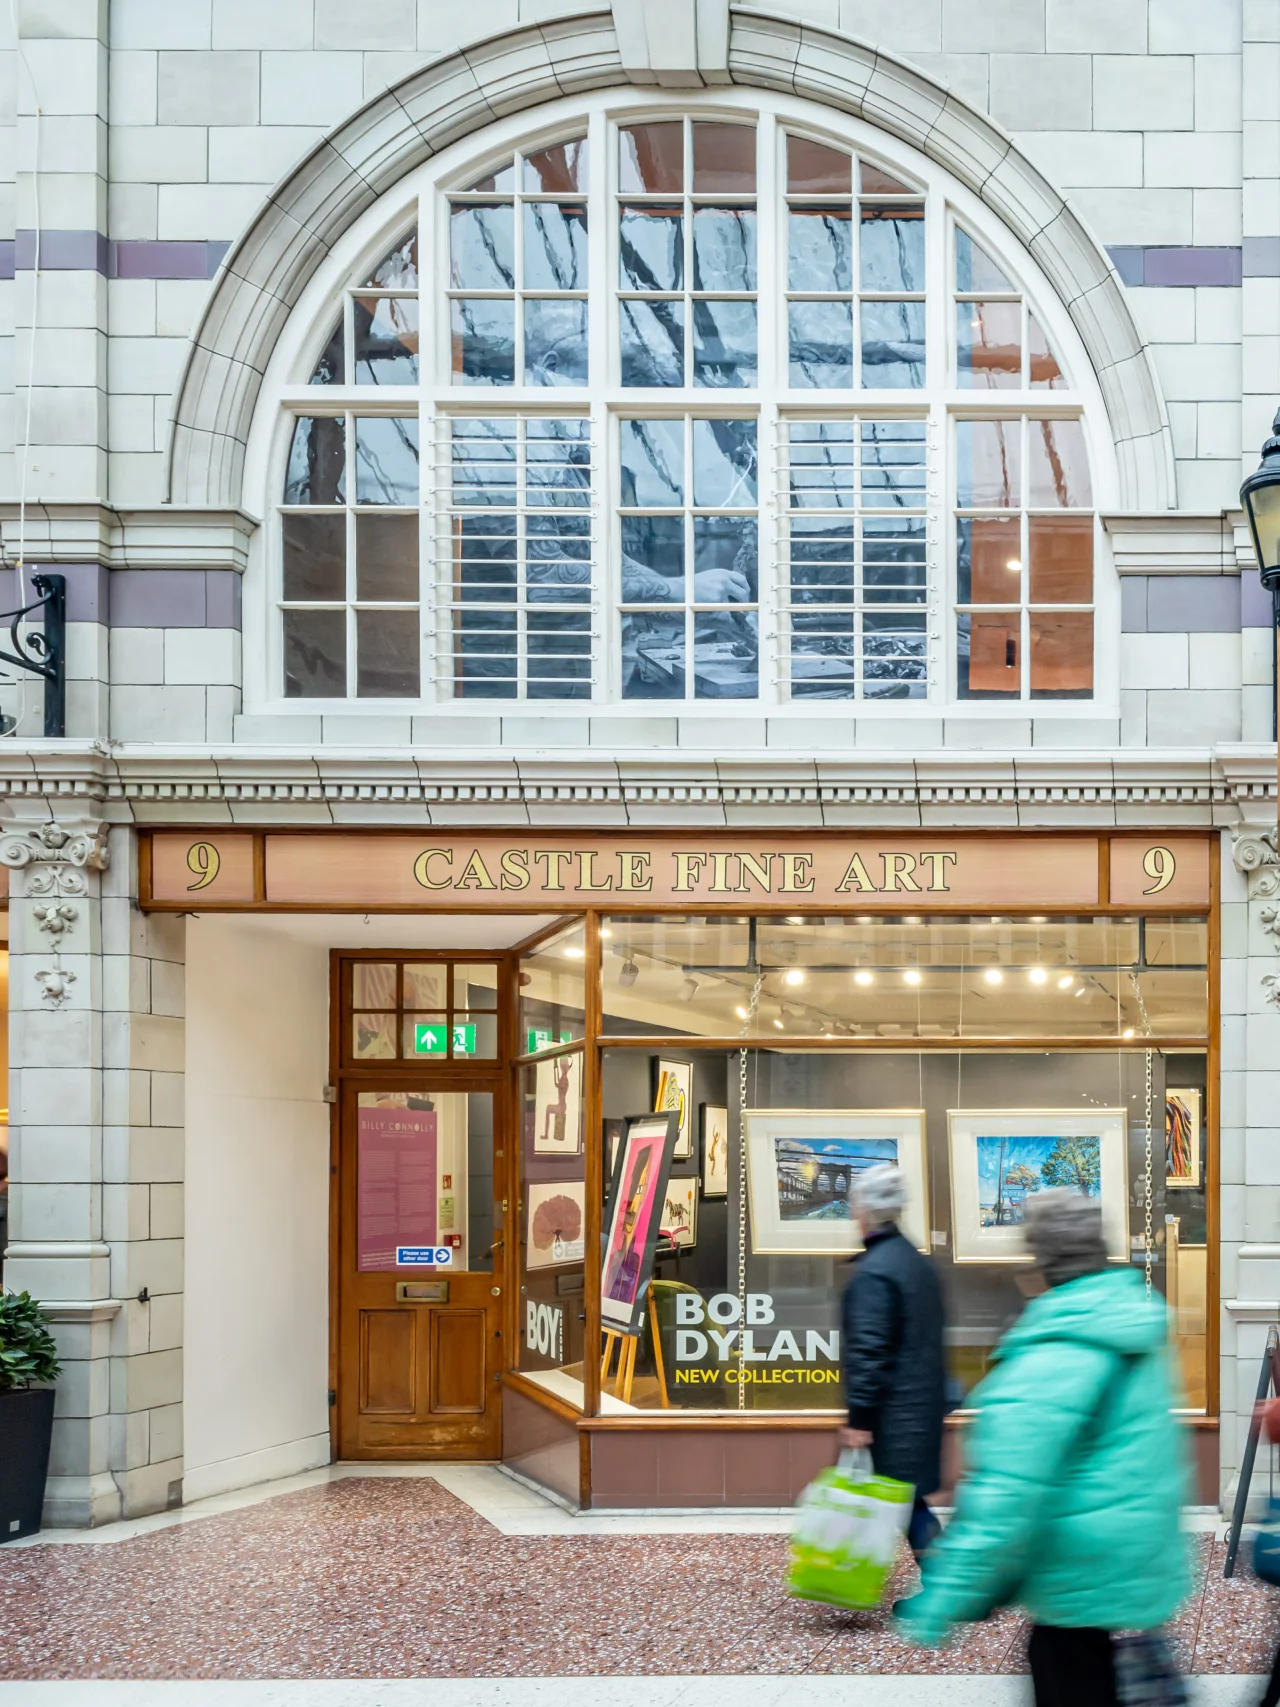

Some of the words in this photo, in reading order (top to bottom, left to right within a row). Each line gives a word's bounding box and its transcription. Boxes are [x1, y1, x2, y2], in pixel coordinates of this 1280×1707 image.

[186, 841, 221, 891] 9
[413, 848, 654, 892] CASTLE
[671, 851, 816, 893] FINE
[834, 851, 957, 892] ART
[1142, 845, 1176, 896] 9
[361, 1120, 385, 1130] BILLY
[388, 1122, 434, 1132] CONNOLLY
[676, 1293, 775, 1325] BOB
[526, 1300, 560, 1359] BOY
[675, 1330, 840, 1361] DYLAN
[675, 1369, 720, 1384] NEW
[724, 1368, 840, 1384] COLLECTION
